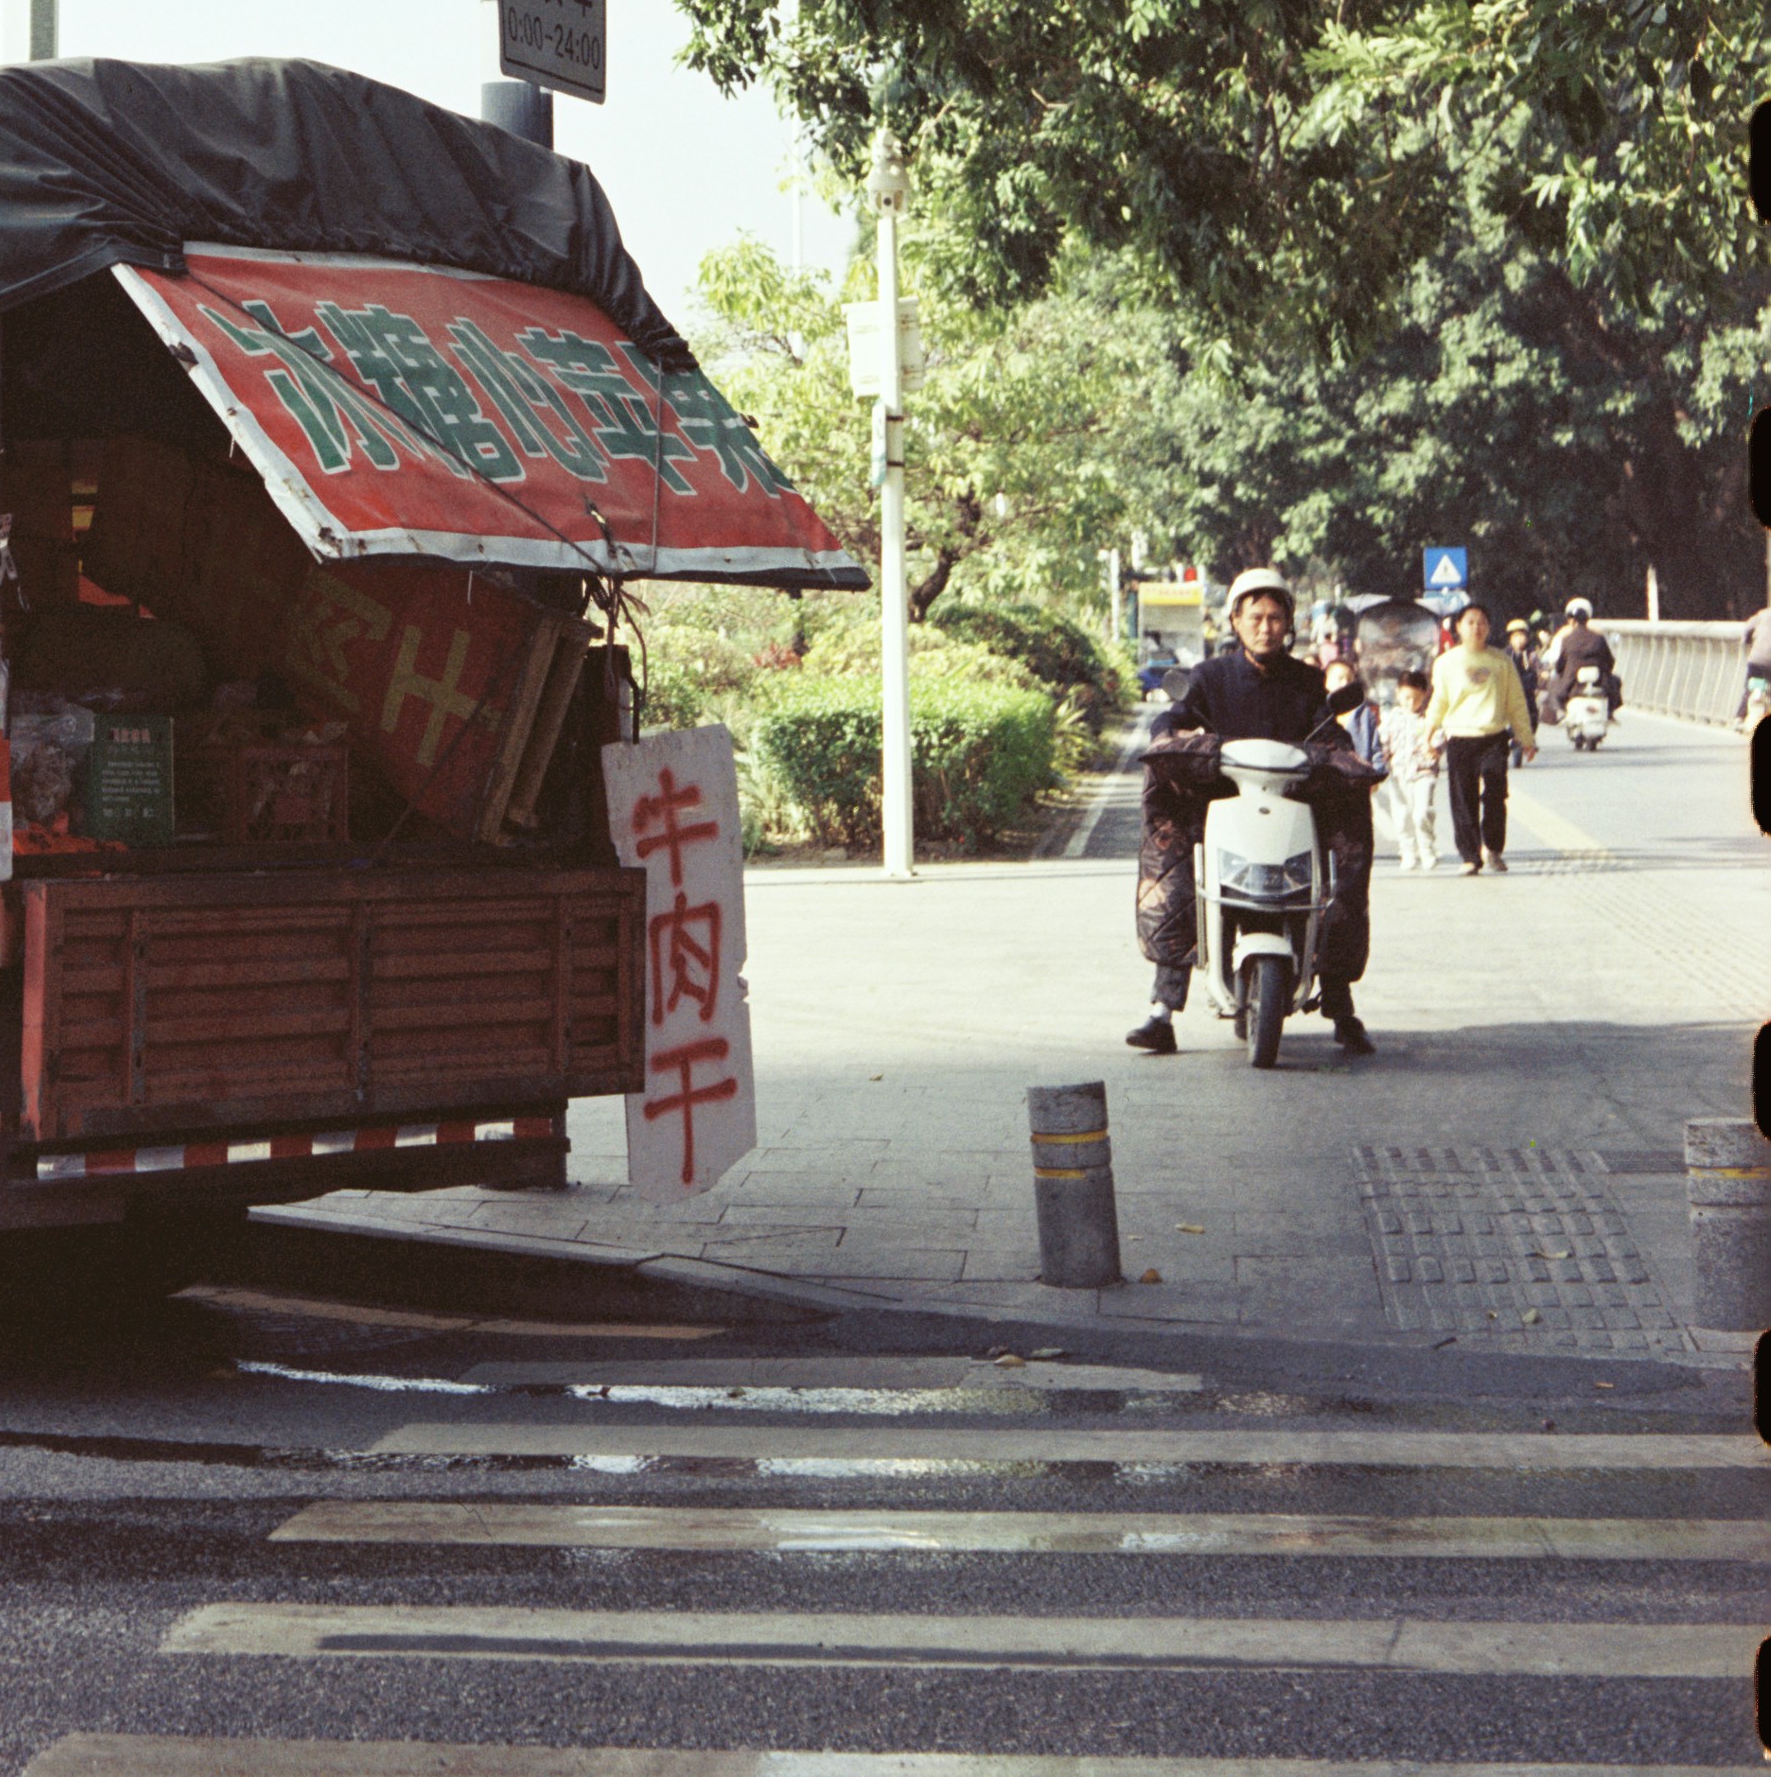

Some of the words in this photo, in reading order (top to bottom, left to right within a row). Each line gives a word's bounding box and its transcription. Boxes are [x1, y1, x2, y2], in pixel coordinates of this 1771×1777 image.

[196, 298, 796, 498] 冰糖心苹果
[631, 766, 738, 1186] 牛肉干
